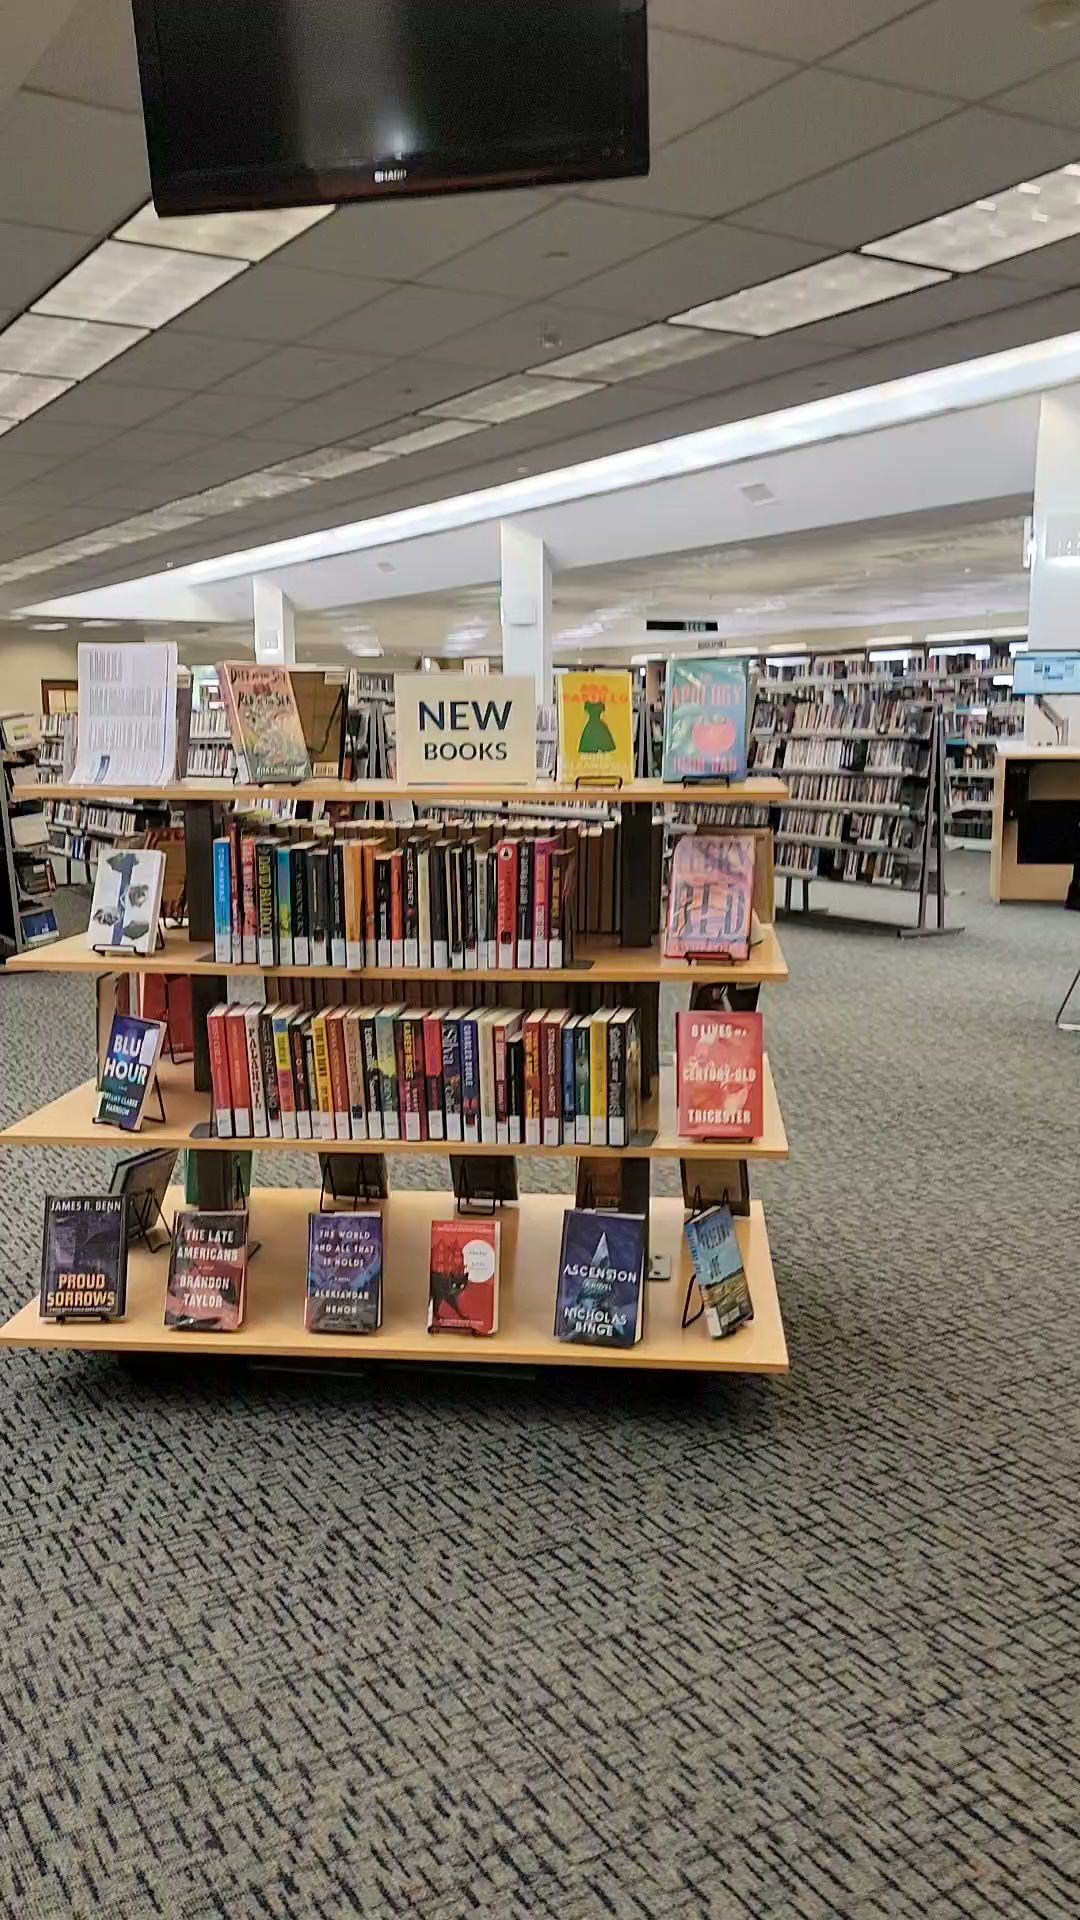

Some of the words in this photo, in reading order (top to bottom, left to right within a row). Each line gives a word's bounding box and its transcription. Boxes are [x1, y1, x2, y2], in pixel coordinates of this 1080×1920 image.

[418, 700, 513, 731] NEW
[424, 742, 508, 761] BOOKS
[113, 1033, 142, 1057] BLU
[103, 1057, 149, 1085] HOUR
[688, 1108, 751, 1124] TRICKSTER
[51, 1200, 81, 1212] JAMES
[95, 1200, 121, 1213] BENN
[185, 1229, 205, 1241] THE
[208, 1230, 234, 1244] LATE
[319, 1229, 335, 1240] THE
[338, 1230, 371, 1241] WORLD
[176, 1246, 239, 1262] AMERICANS
[314, 1243, 332, 1253] AND
[335, 1244, 351, 1254] ALL
[354, 1245, 374, 1255] THAT
[58, 1273, 105, 1290] PROUD
[180, 1274, 229, 1290] BRANDON
[562, 1263, 637, 1284] ASCENSION
[47, 1290, 115, 1308] SORROWS
[183, 1293, 223, 1308] TAYLOR
[563, 1306, 628, 1326] NICHOLAS
[575, 1319, 614, 1337] BINGE
